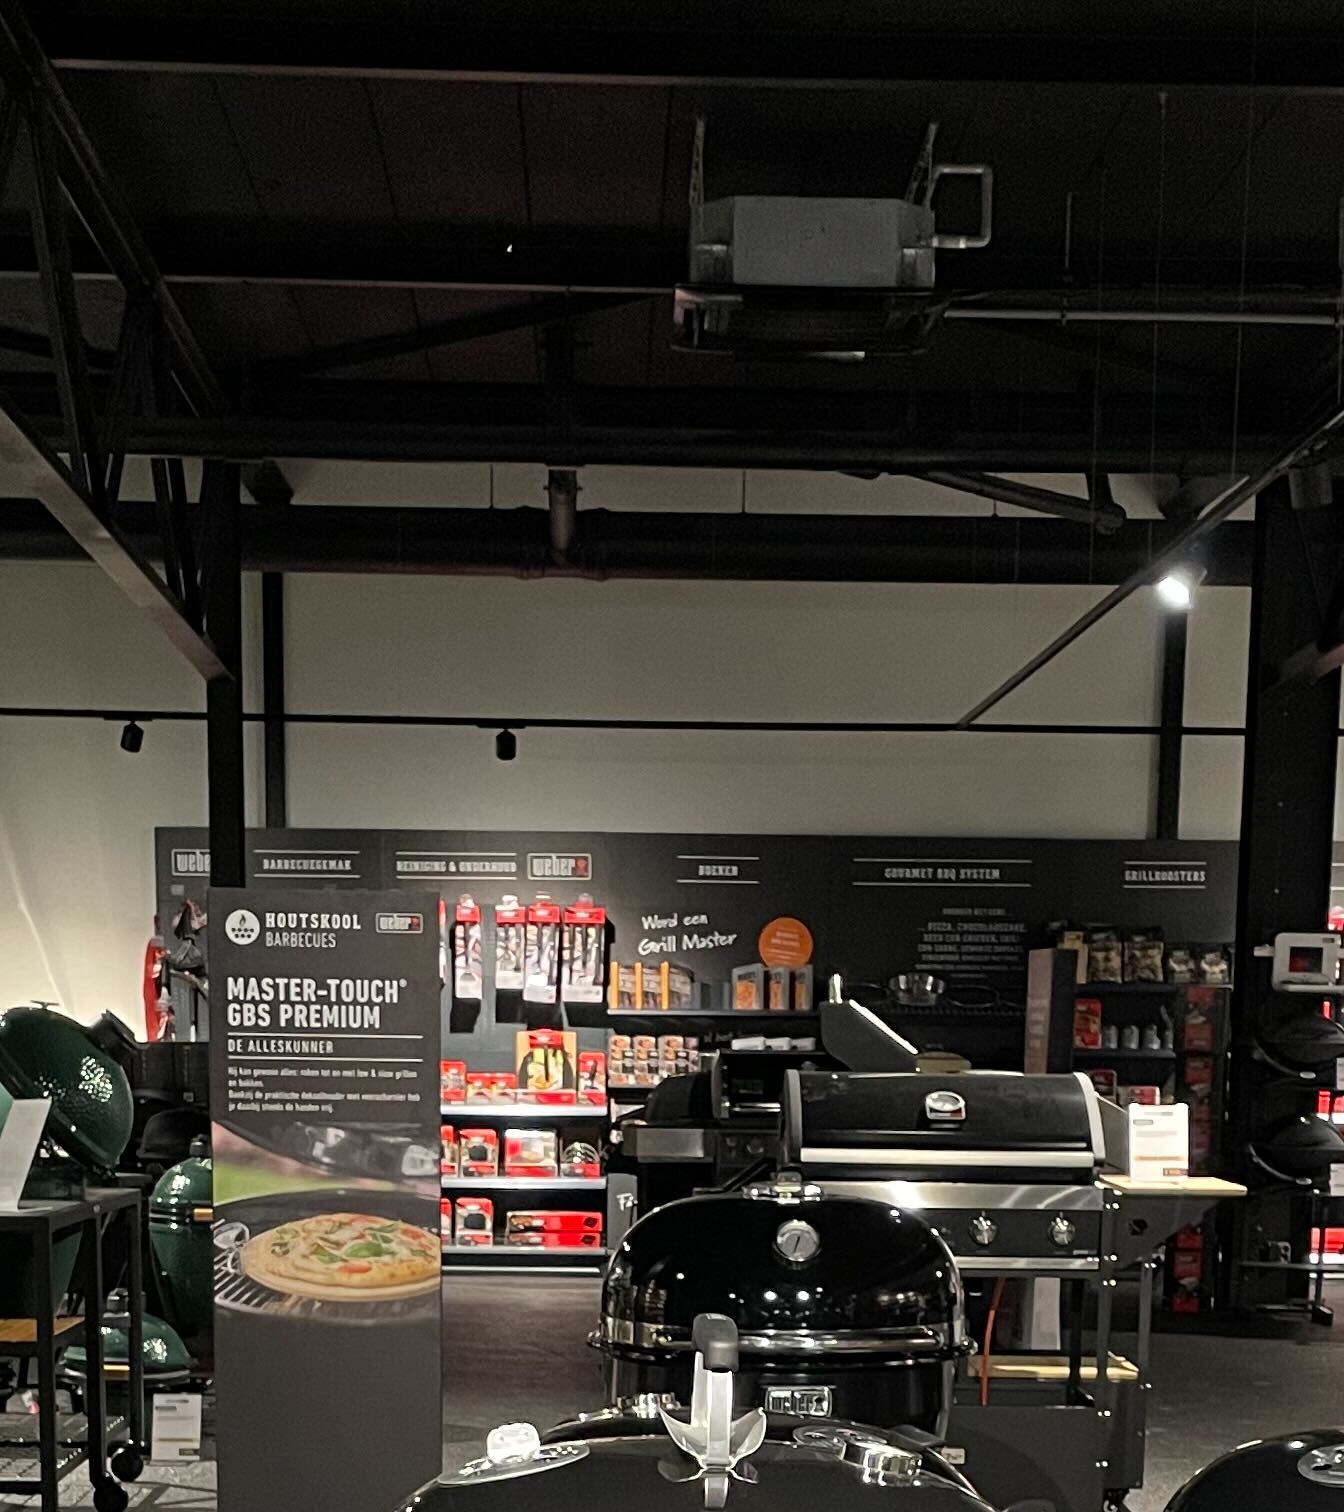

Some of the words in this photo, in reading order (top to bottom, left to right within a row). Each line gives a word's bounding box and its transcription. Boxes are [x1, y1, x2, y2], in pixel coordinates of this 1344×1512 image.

[177, 850, 210, 872] webe
[532, 854, 576, 877] weber
[265, 912, 362, 930] HOUTSKOOL
[641, 912, 678, 930] Word
[682, 914, 709, 926] een
[265, 931, 337, 948] BARBECUES
[637, 934, 677, 956] Grill
[681, 931, 737, 951] Master
[227, 1003, 271, 1027] GBS
[279, 1004, 381, 1029] PREMIUM
[227, 1039, 243, 1053] DE
[247, 1039, 334, 1054] ALLESKUNNER
